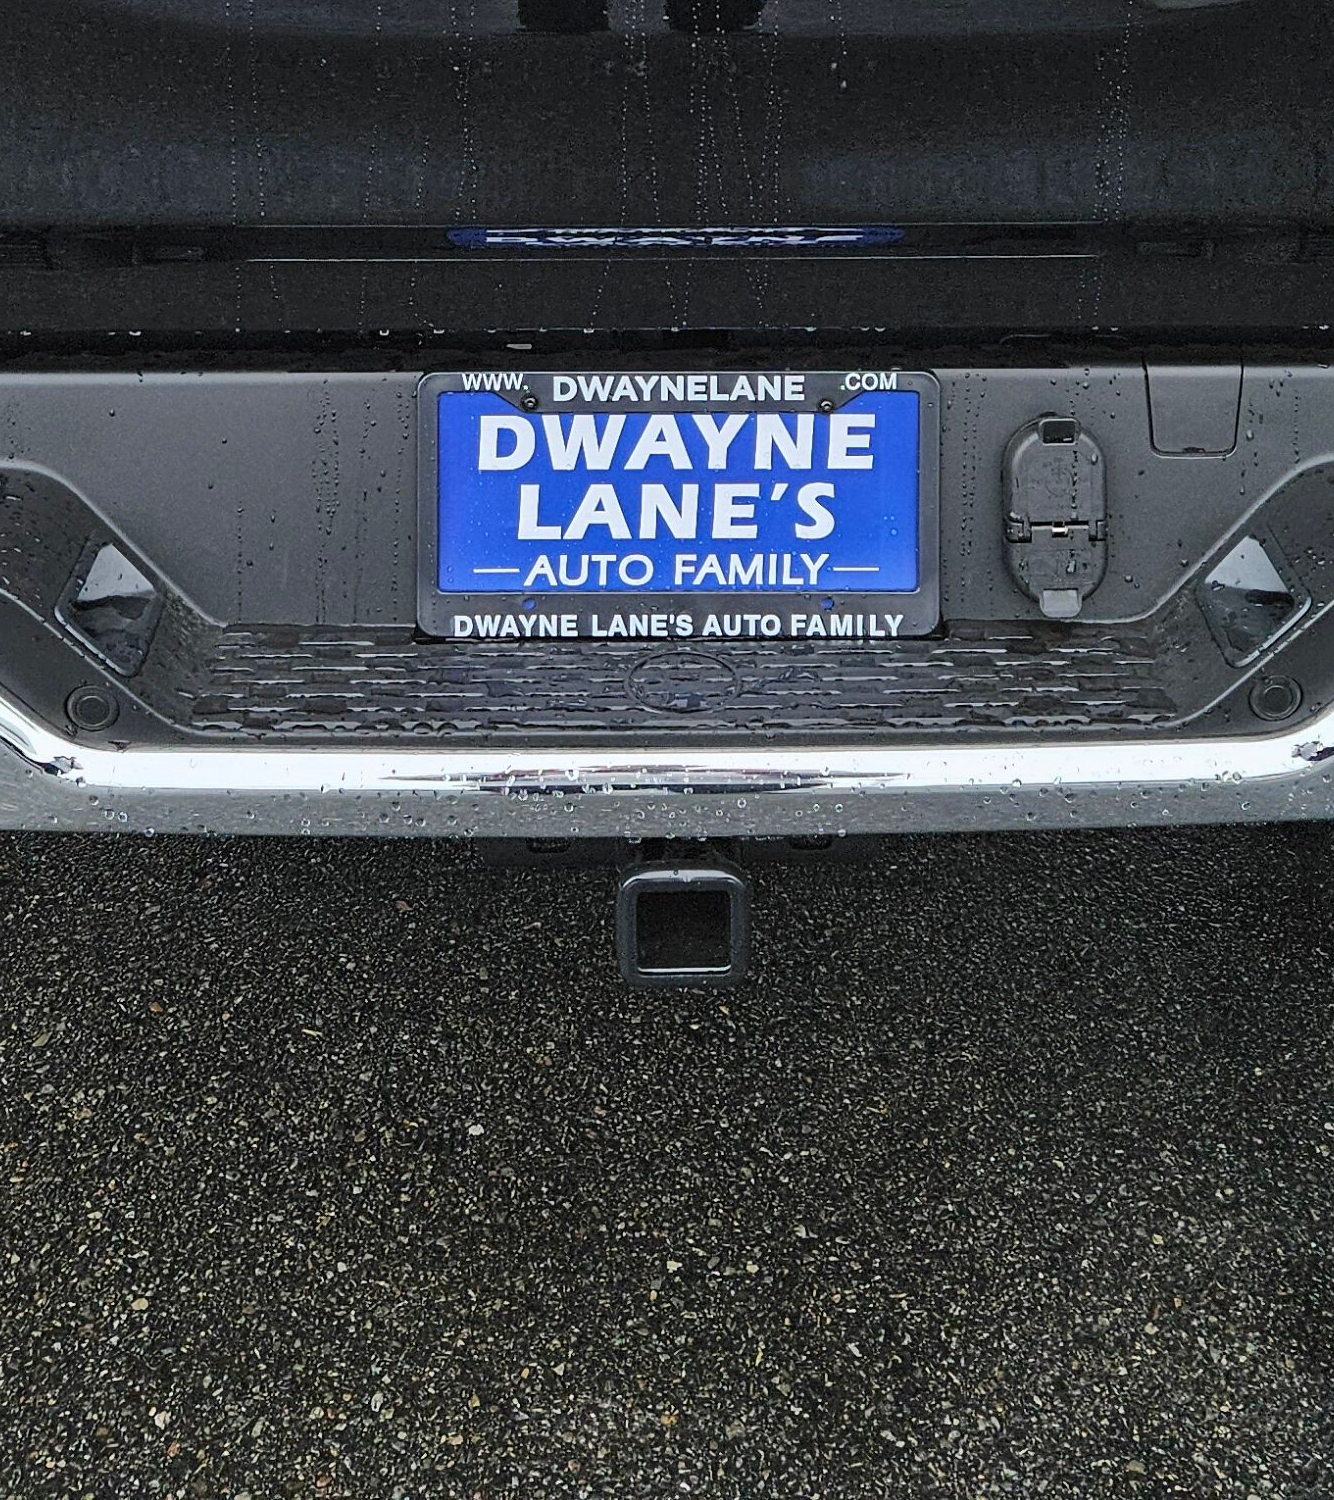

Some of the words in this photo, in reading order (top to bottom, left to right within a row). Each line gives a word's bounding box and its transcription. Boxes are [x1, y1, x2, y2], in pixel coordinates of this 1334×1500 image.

[552, 374, 805, 402] DWAYNELANE
[840, 371, 898, 391] .COM
[478, 413, 876, 471] DWAYNE
[517, 481, 836, 541] LANE'S
[523, 553, 655, 587] AUTO
[674, 552, 830, 586] FAMILY
[453, 614, 578, 638] DWAYNE
[591, 614, 694, 638] LANE'S
[702, 614, 782, 638] AUTO
[790, 613, 905, 637] FAMILY
